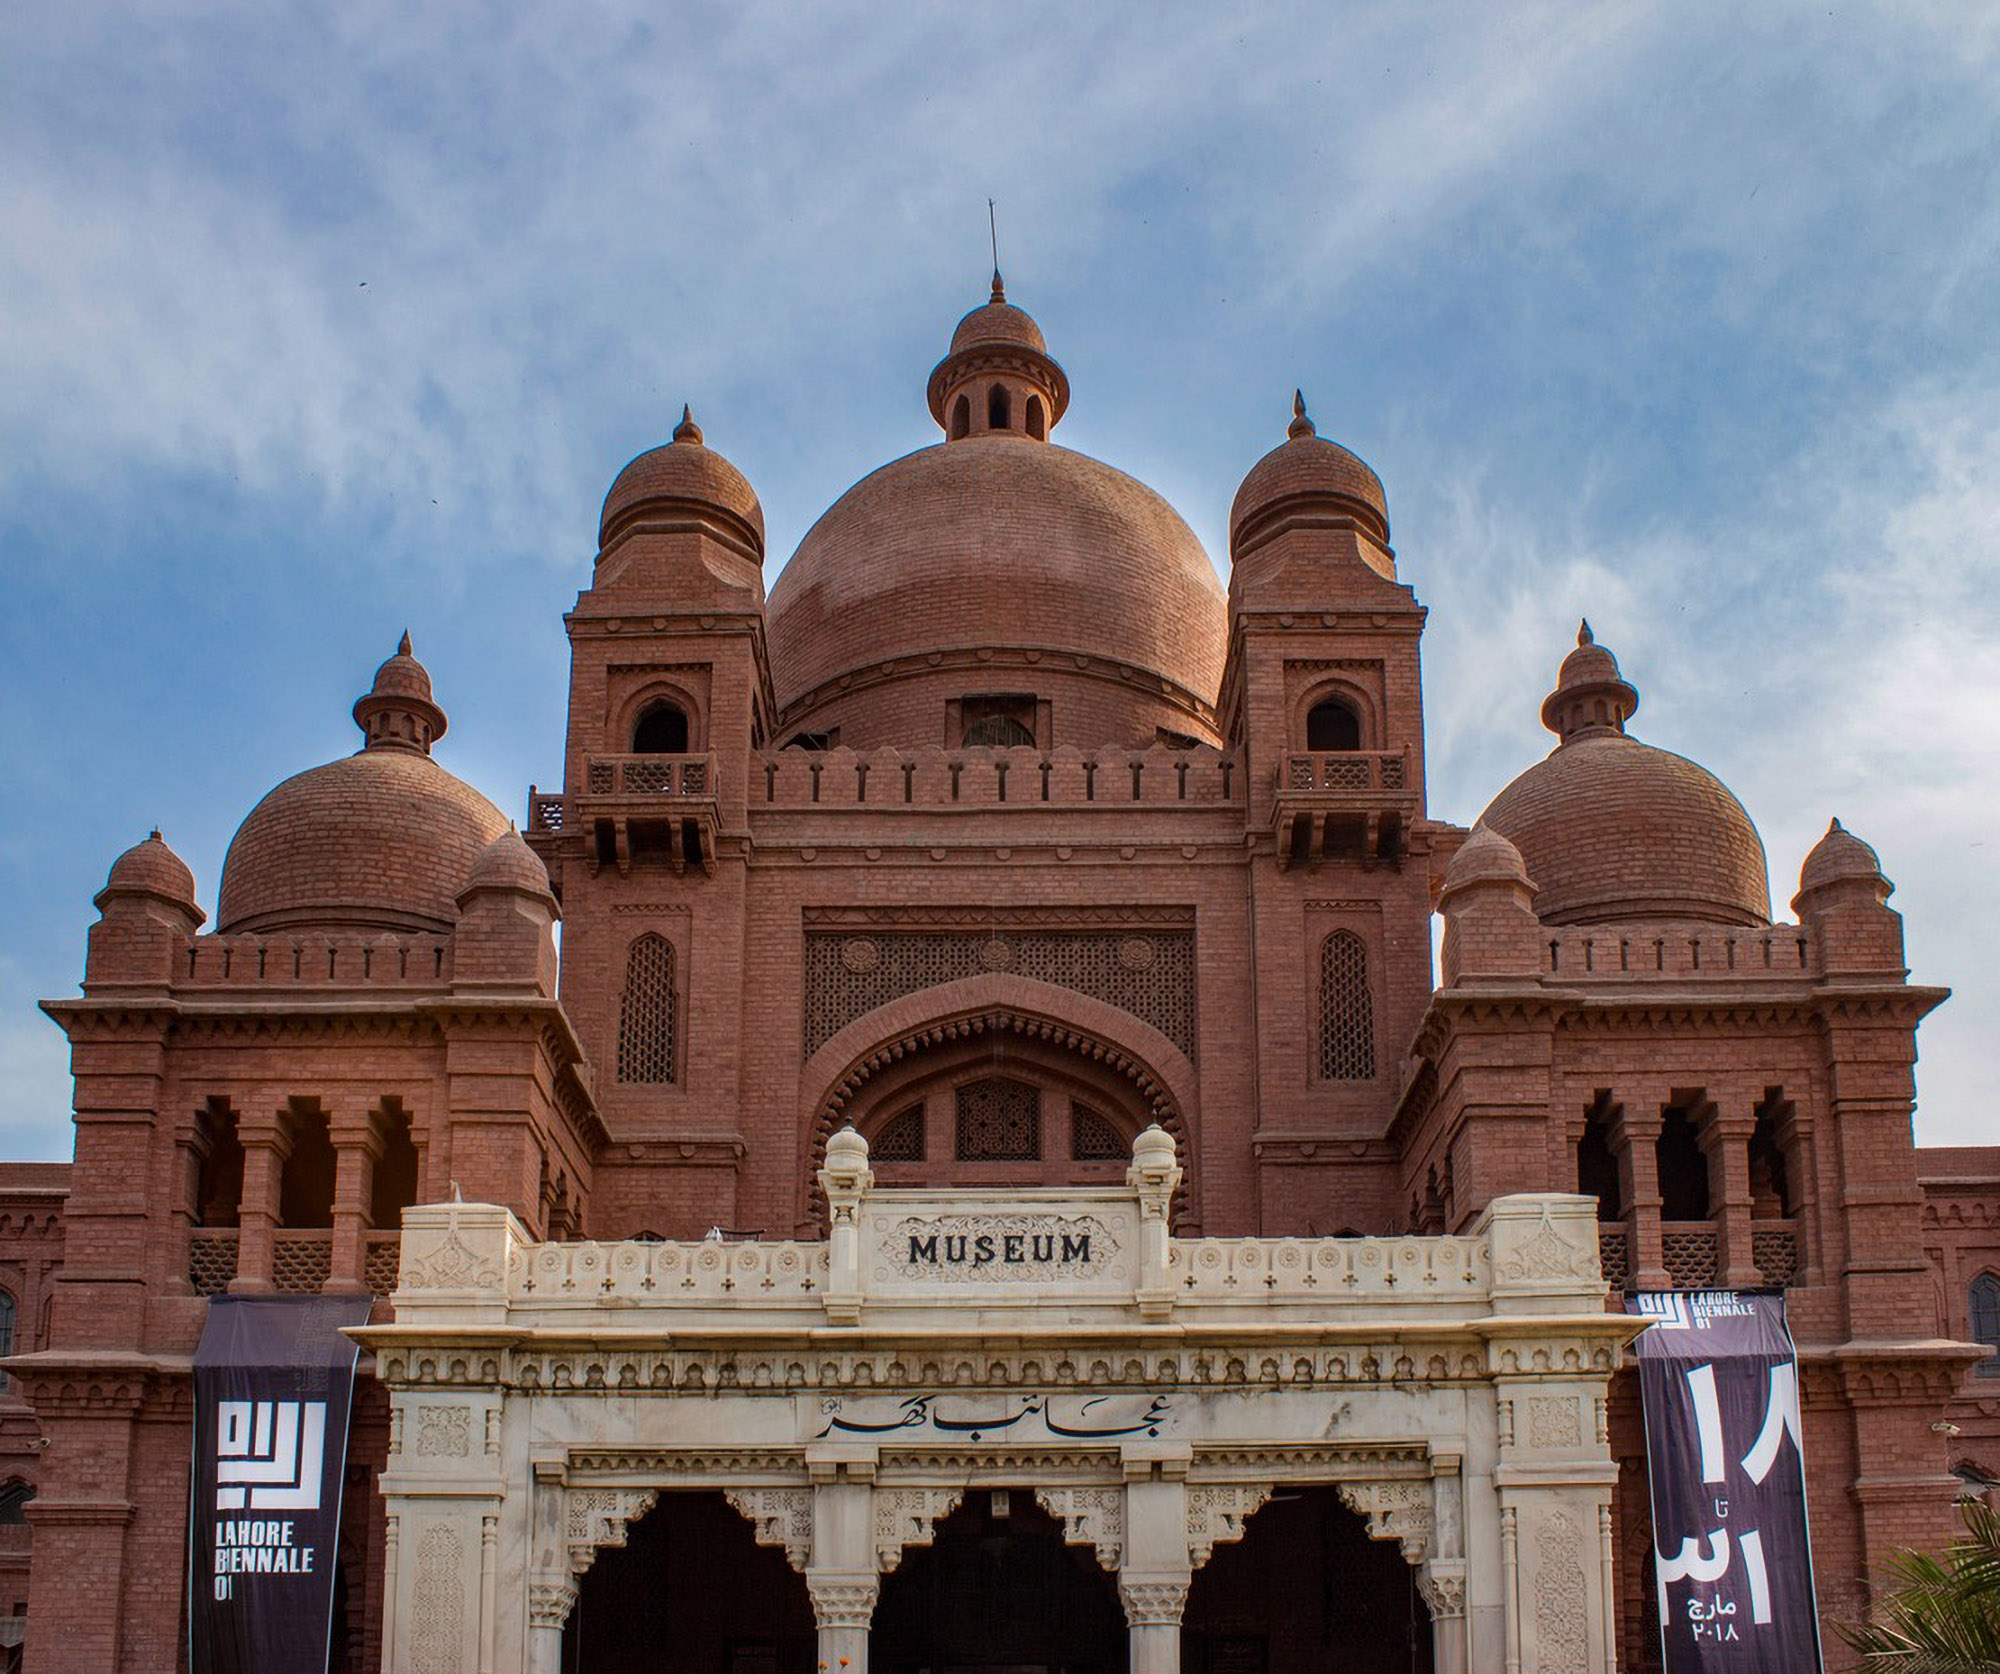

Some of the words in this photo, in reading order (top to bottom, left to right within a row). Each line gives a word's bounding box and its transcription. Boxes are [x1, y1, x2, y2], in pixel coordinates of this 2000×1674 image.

[908, 1234, 1091, 1264] MUSEUM
[1690, 1292, 1740, 1305] LAHORE
[1692, 1304, 1756, 1318] BIENNALE
[1696, 1317, 1711, 1329] 01
[1715, 1499, 1729, 1518] تا
[215, 1521, 295, 1547] LAHORE
[214, 1547, 315, 1574] BIENNALE
[1687, 1594, 1737, 1621] مارچ
